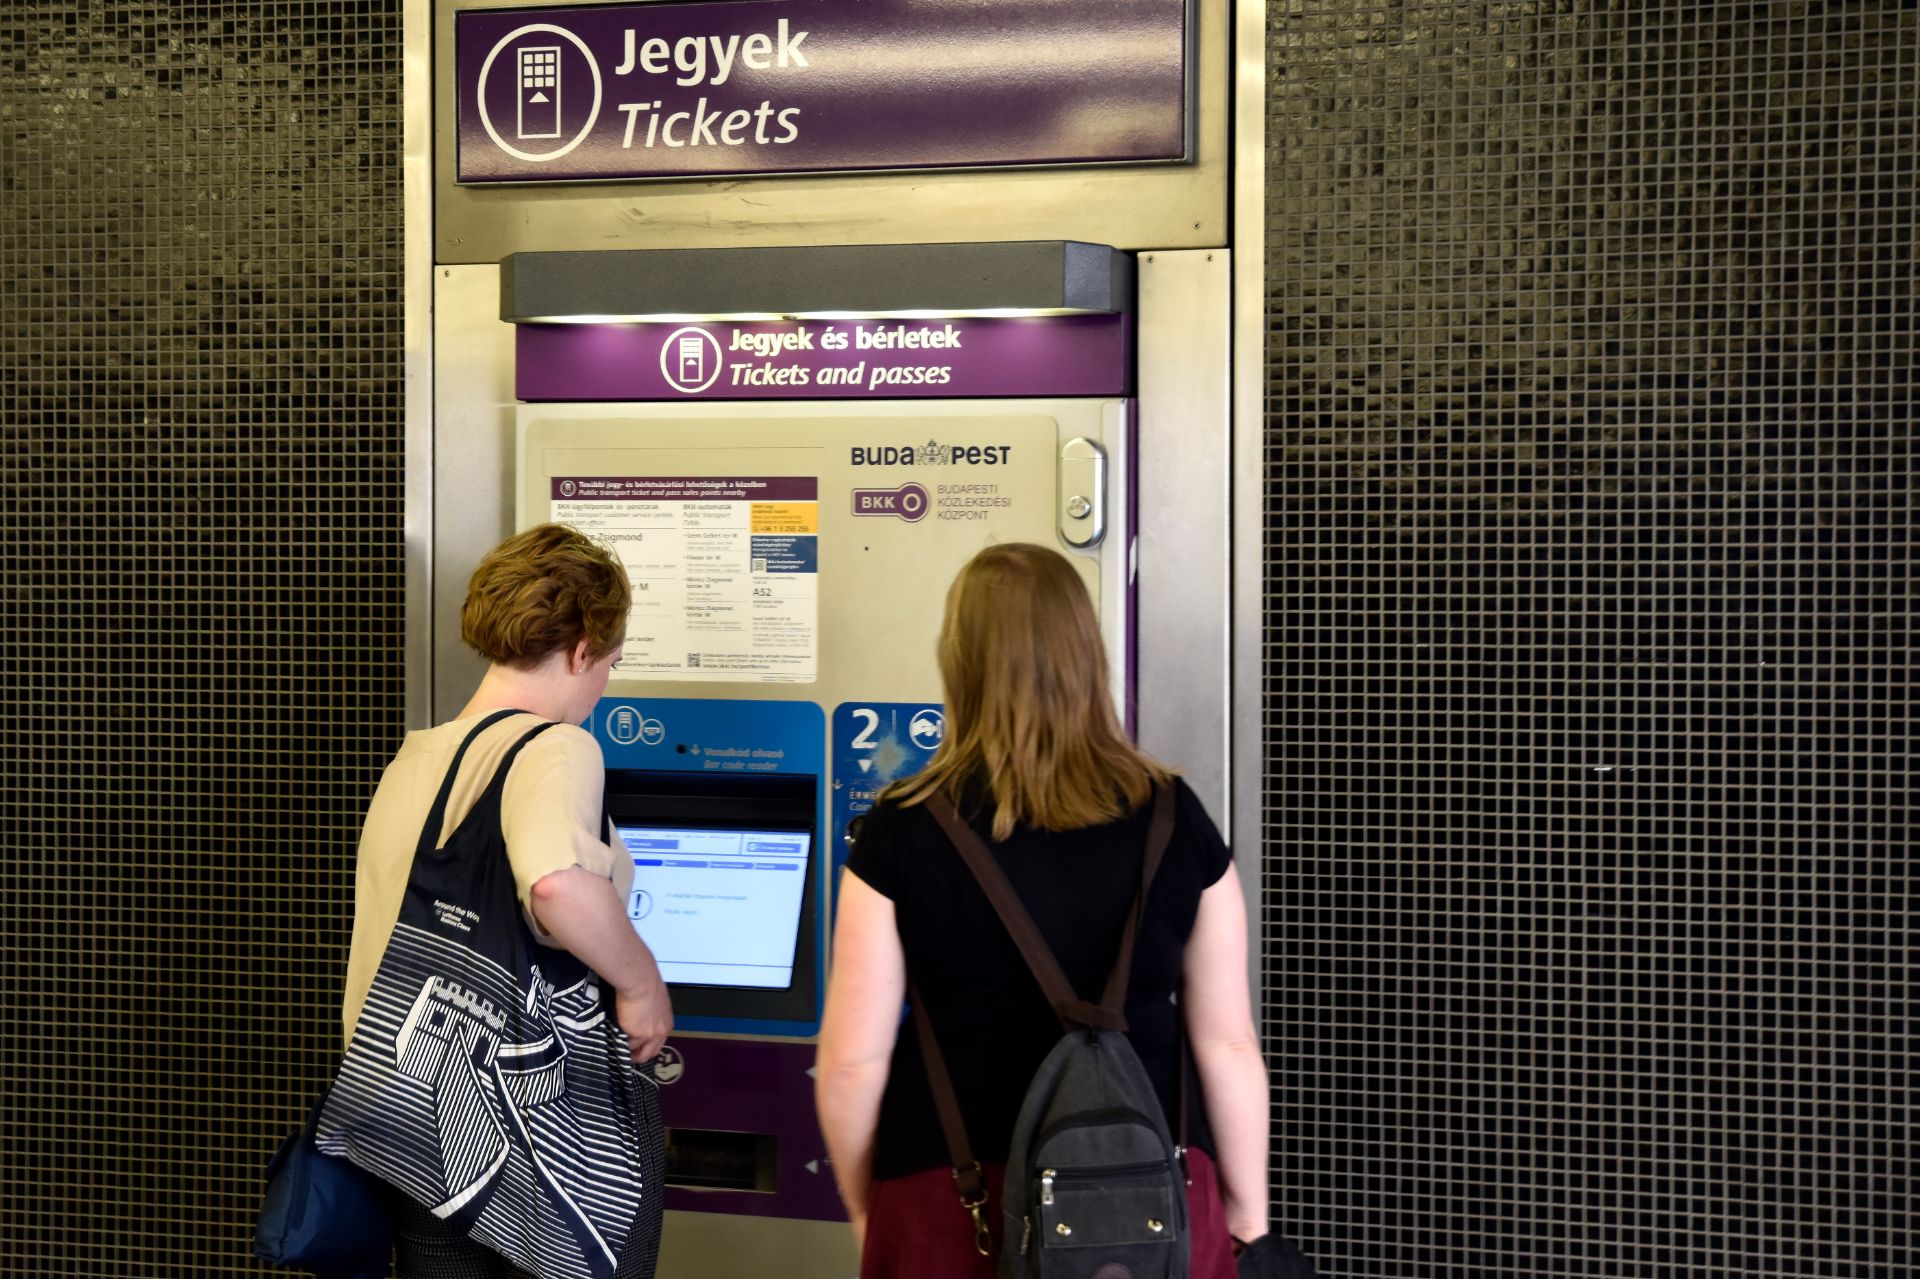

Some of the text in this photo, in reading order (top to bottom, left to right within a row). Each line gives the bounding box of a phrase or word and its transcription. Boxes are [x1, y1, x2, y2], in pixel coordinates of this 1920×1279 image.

[615, 18, 810, 87] Jegyek
[617, 97, 801, 149] Tickets
[729, 325, 962, 357] Jegyek és bérletek
[730, 361, 952, 391] Tickets and passes
[599, 489, 630, 498] transport
[937, 484, 998, 495] BUDAPESTI
[861, 496, 895, 509] BKK
[937, 495, 1012, 508] KÖZLEKEDÉSI
[937, 508, 989, 521] KÖZPONT
[599, 532, 643, 543] Zsigmond
[851, 708, 880, 749] 2
[434, 899, 456, 912] Around
[455, 906, 467, 916] the
